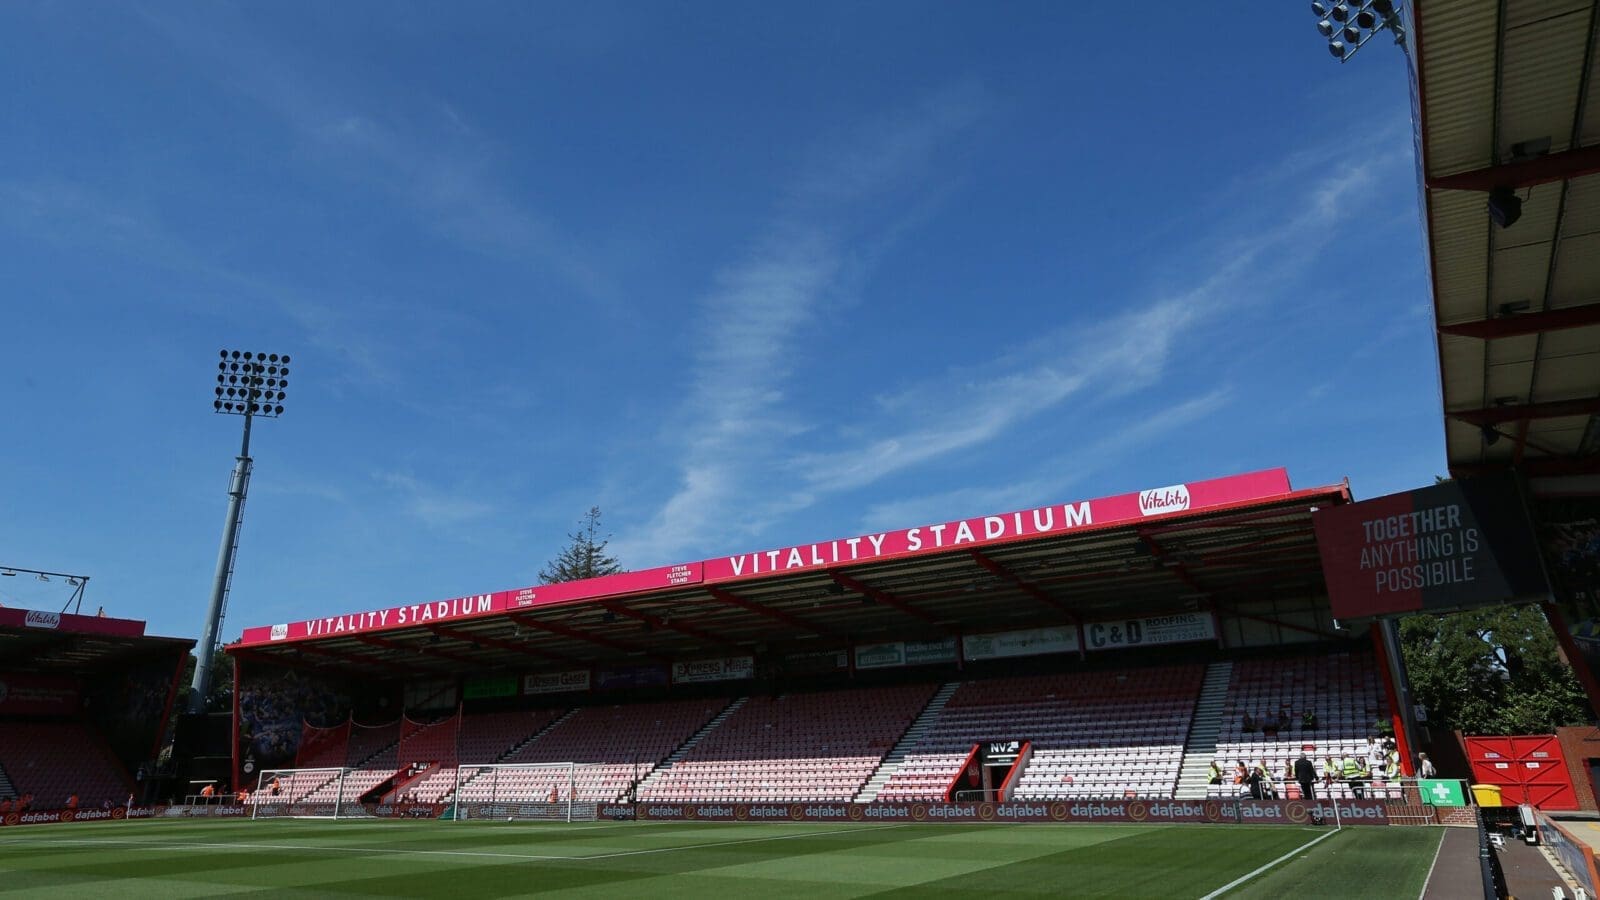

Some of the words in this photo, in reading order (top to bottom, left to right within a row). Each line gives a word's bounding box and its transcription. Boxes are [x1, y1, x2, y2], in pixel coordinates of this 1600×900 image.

[1141, 491, 1188, 510] Vitality
[1363, 504, 1461, 543] TOGETHER
[730, 534, 886, 576] VITALITY
[907, 501, 1092, 551] STADIUM
[1360, 533, 1453, 570] ANYTHING
[1460, 528, 1479, 554] IS
[666, 571, 691, 579] FLETCHER
[672, 565, 687, 573] STEVE
[1376, 557, 1475, 595] POSSIBILE
[28, 611, 59, 625] Vitality
[306, 610, 389, 636] VITALITY
[398, 594, 492, 624] STADIUM
[1146, 614, 1197, 626] ROOFING
[1089, 623, 1106, 647] C
[1110, 626, 1123, 643] &
[1126, 620, 1143, 644] D
[21, 812, 59, 823] dafabet
[75, 810, 111, 819] dafabet
[602, 805, 635, 816] dafabet
[649, 806, 682, 817] dafabet
[697, 806, 733, 817] dafabet
[750, 805, 788, 817] dafabet
[805, 804, 847, 818] dafabet
[865, 804, 909, 818] dafabet
[928, 803, 975, 818] dafabet
[997, 803, 1047, 818] dafabet
[1071, 803, 1125, 819] dafabet
[1149, 803, 1204, 819] dafabet
